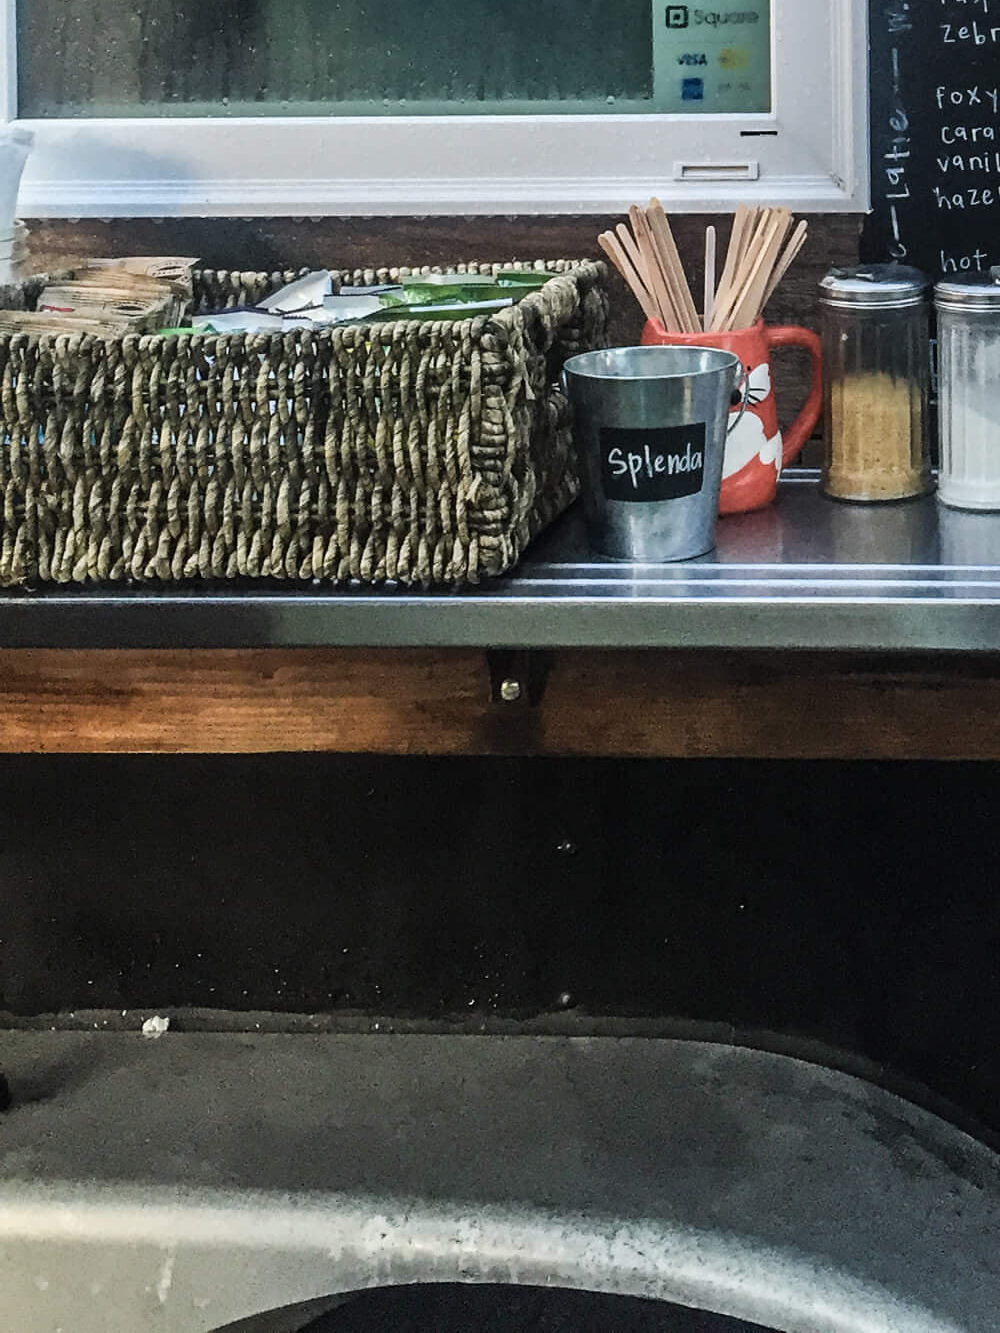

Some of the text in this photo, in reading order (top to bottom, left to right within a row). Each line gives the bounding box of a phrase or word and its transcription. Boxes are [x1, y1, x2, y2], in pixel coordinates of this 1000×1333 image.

[936, 86, 998, 113] foxy
[940, 249, 988, 273] hot
[608, 443, 702, 488] Splenda
